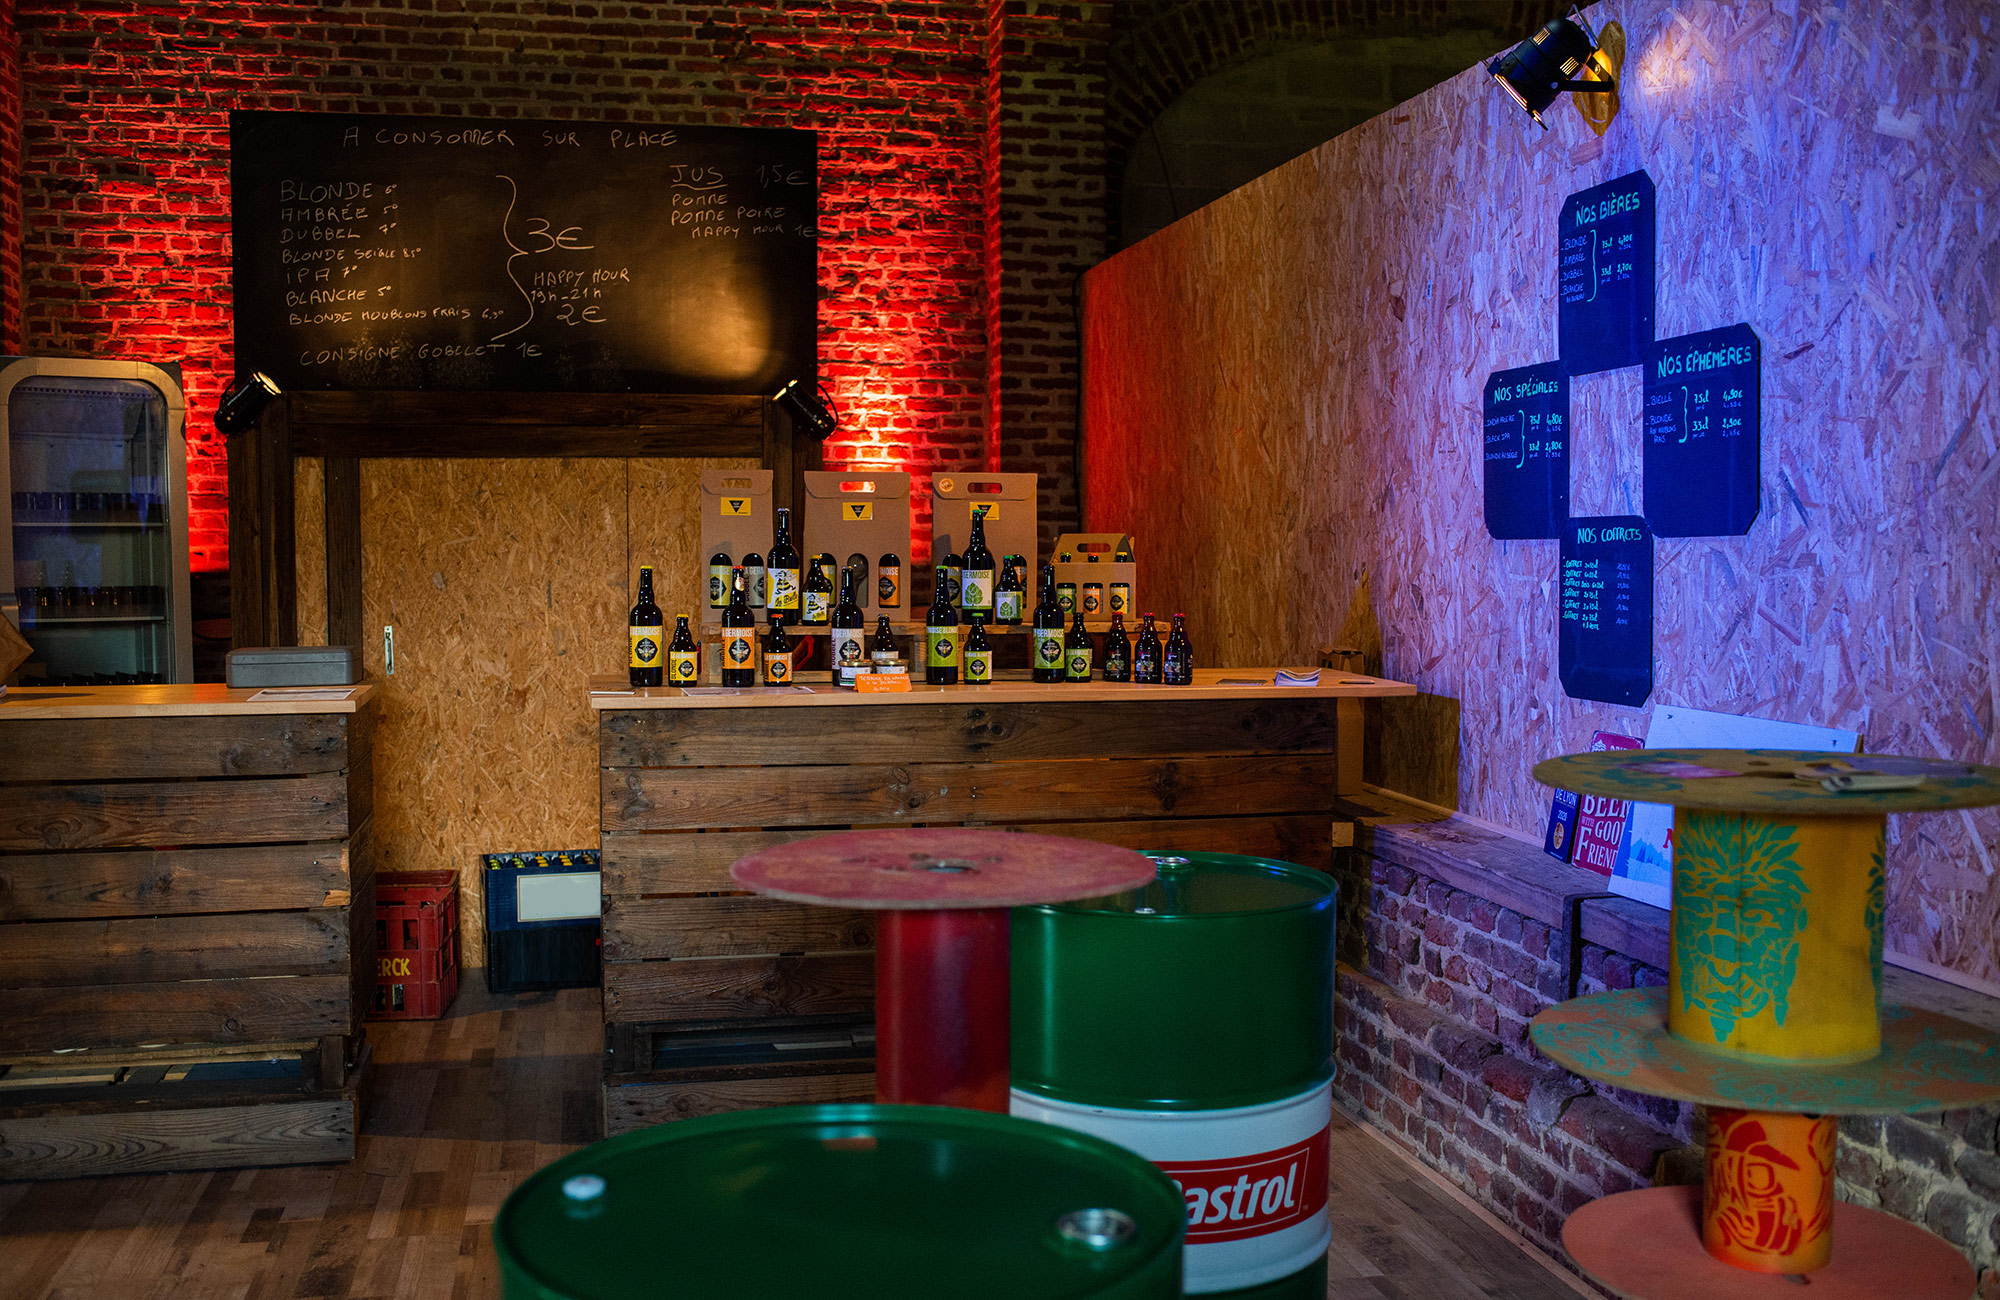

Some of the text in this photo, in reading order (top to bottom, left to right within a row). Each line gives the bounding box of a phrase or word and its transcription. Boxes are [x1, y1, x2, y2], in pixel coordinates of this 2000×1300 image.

[343, 126, 359, 147] A
[542, 130, 580, 147] SUR
[610, 129, 678, 148] PLACE
[669, 163, 810, 188] JUS 1,5€
[279, 179, 374, 204] BLONDE
[671, 193, 728, 207] POMME
[280, 203, 369, 223] AMBRÉE
[671, 206, 786, 226] POMME POIRE
[1575, 192, 1640, 227] NOS BIÈRES
[279, 227, 361, 244] DUBBEL
[526, 217, 594, 253] 3€
[691, 226, 741, 240] HAPPY
[752, 223, 785, 236] HOUR
[281, 249, 345, 264] BLONDE
[353, 247, 397, 260] SEIGLE
[533, 267, 630, 288] HAPPY HOUR
[286, 288, 368, 307] BLANCHE
[289, 311, 353, 326] BLONDE
[361, 308, 428, 321] HOUBLONS
[432, 305, 471, 319] FRAIS
[556, 303, 608, 326] 2€
[300, 344, 401, 366] CONSIGNE
[418, 342, 506, 359] GOBELET
[1657, 342, 1752, 379] NOS ÉPHÉMÈRES
[1494, 377, 1559, 404] NOS SPÉCIALES
[1577, 526, 1642, 544] NOS COFFRETS
[1563, 790, 1576, 806] LYON
[1594, 820, 1626, 846] GOO
[1172, 1162, 1298, 1225] astrol
